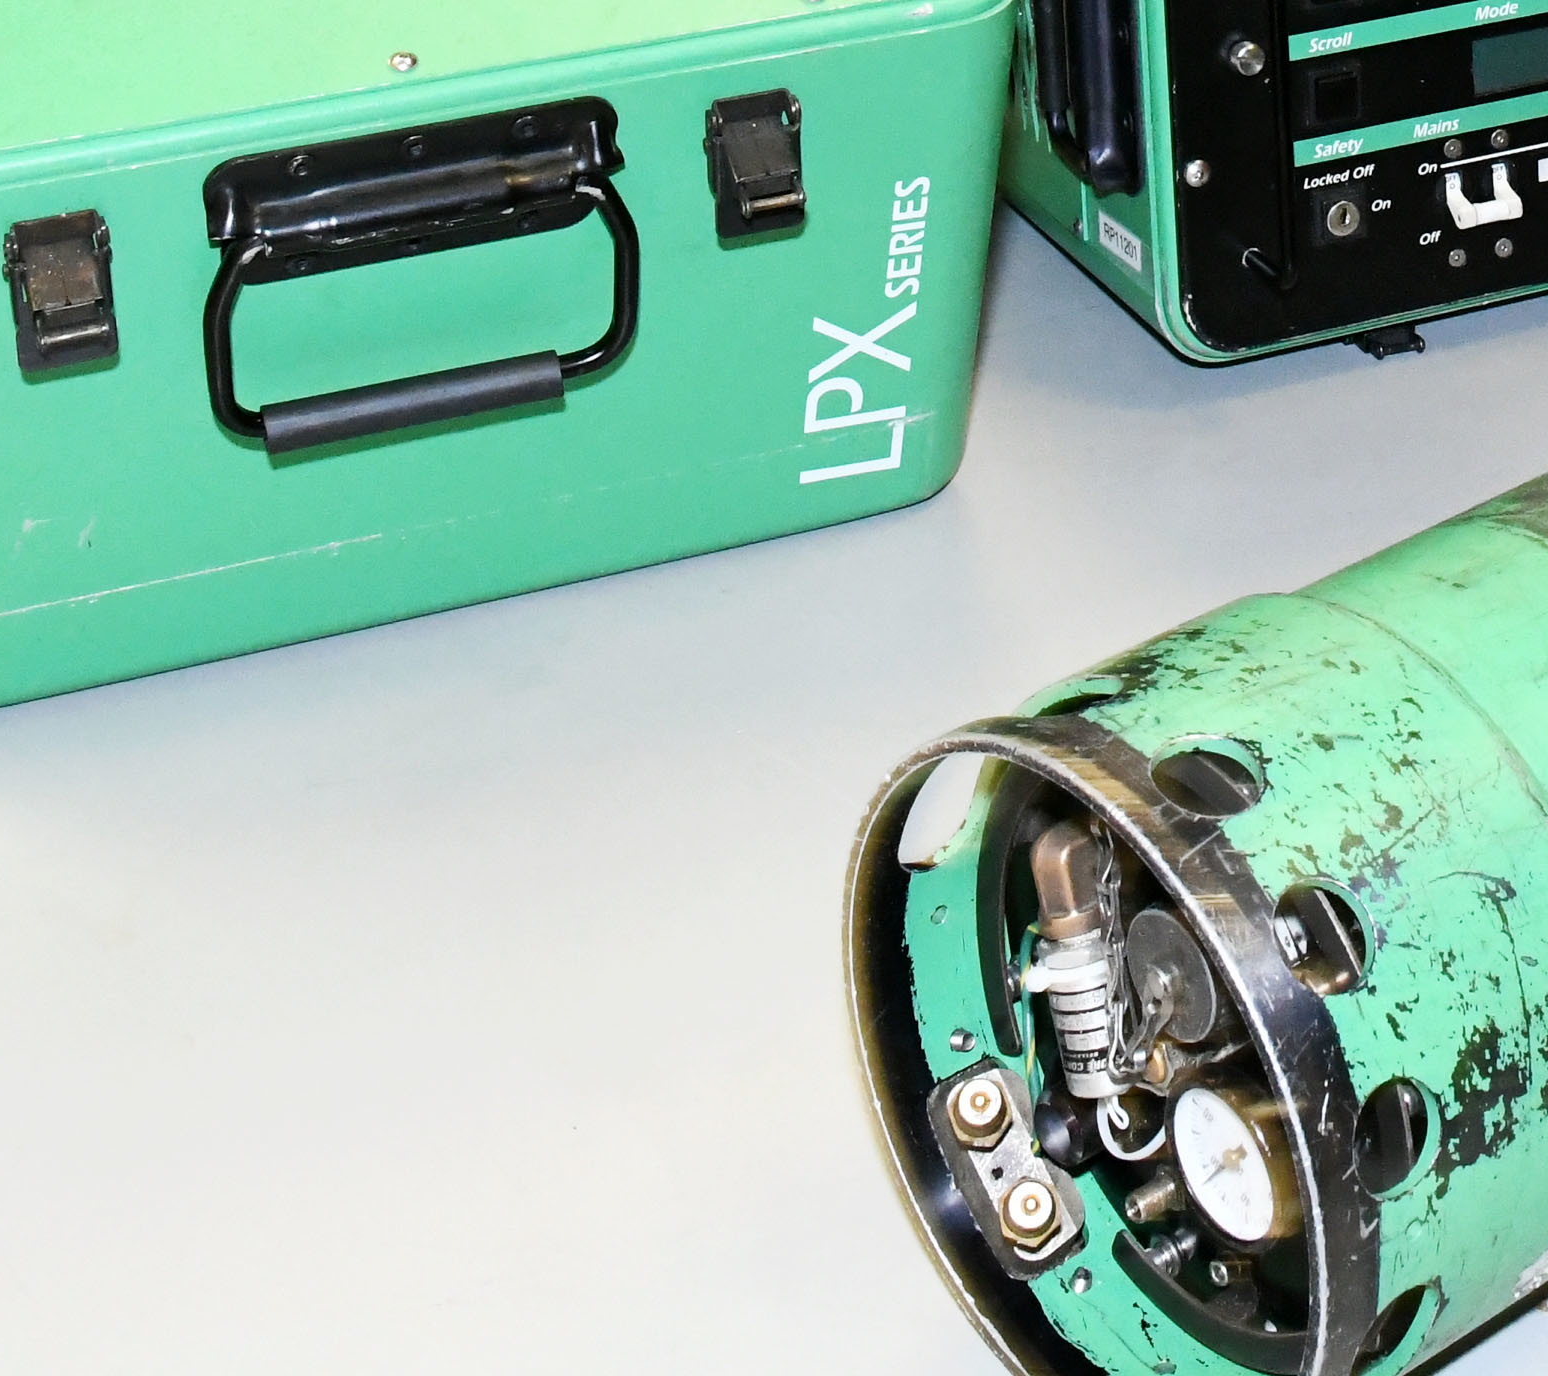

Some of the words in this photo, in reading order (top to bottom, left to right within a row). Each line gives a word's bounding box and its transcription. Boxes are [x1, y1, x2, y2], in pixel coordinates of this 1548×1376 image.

[1475, 1, 1519, 22] Mode
[1308, 31, 1353, 54] Scroll
[1412, 116, 1460, 139] Mains
[1313, 136, 1364, 161] Safety
[1303, 170, 1349, 191] Locked
[1353, 164, 1376, 180] Off
[1418, 161, 1438, 176] On
[1371, 197, 1392, 212] On
[884, 174, 932, 298] SERIES
[1103, 222, 1139, 261] RP11201
[1419, 229, 1441, 246] Off
[799, 301, 919, 486] LPX
